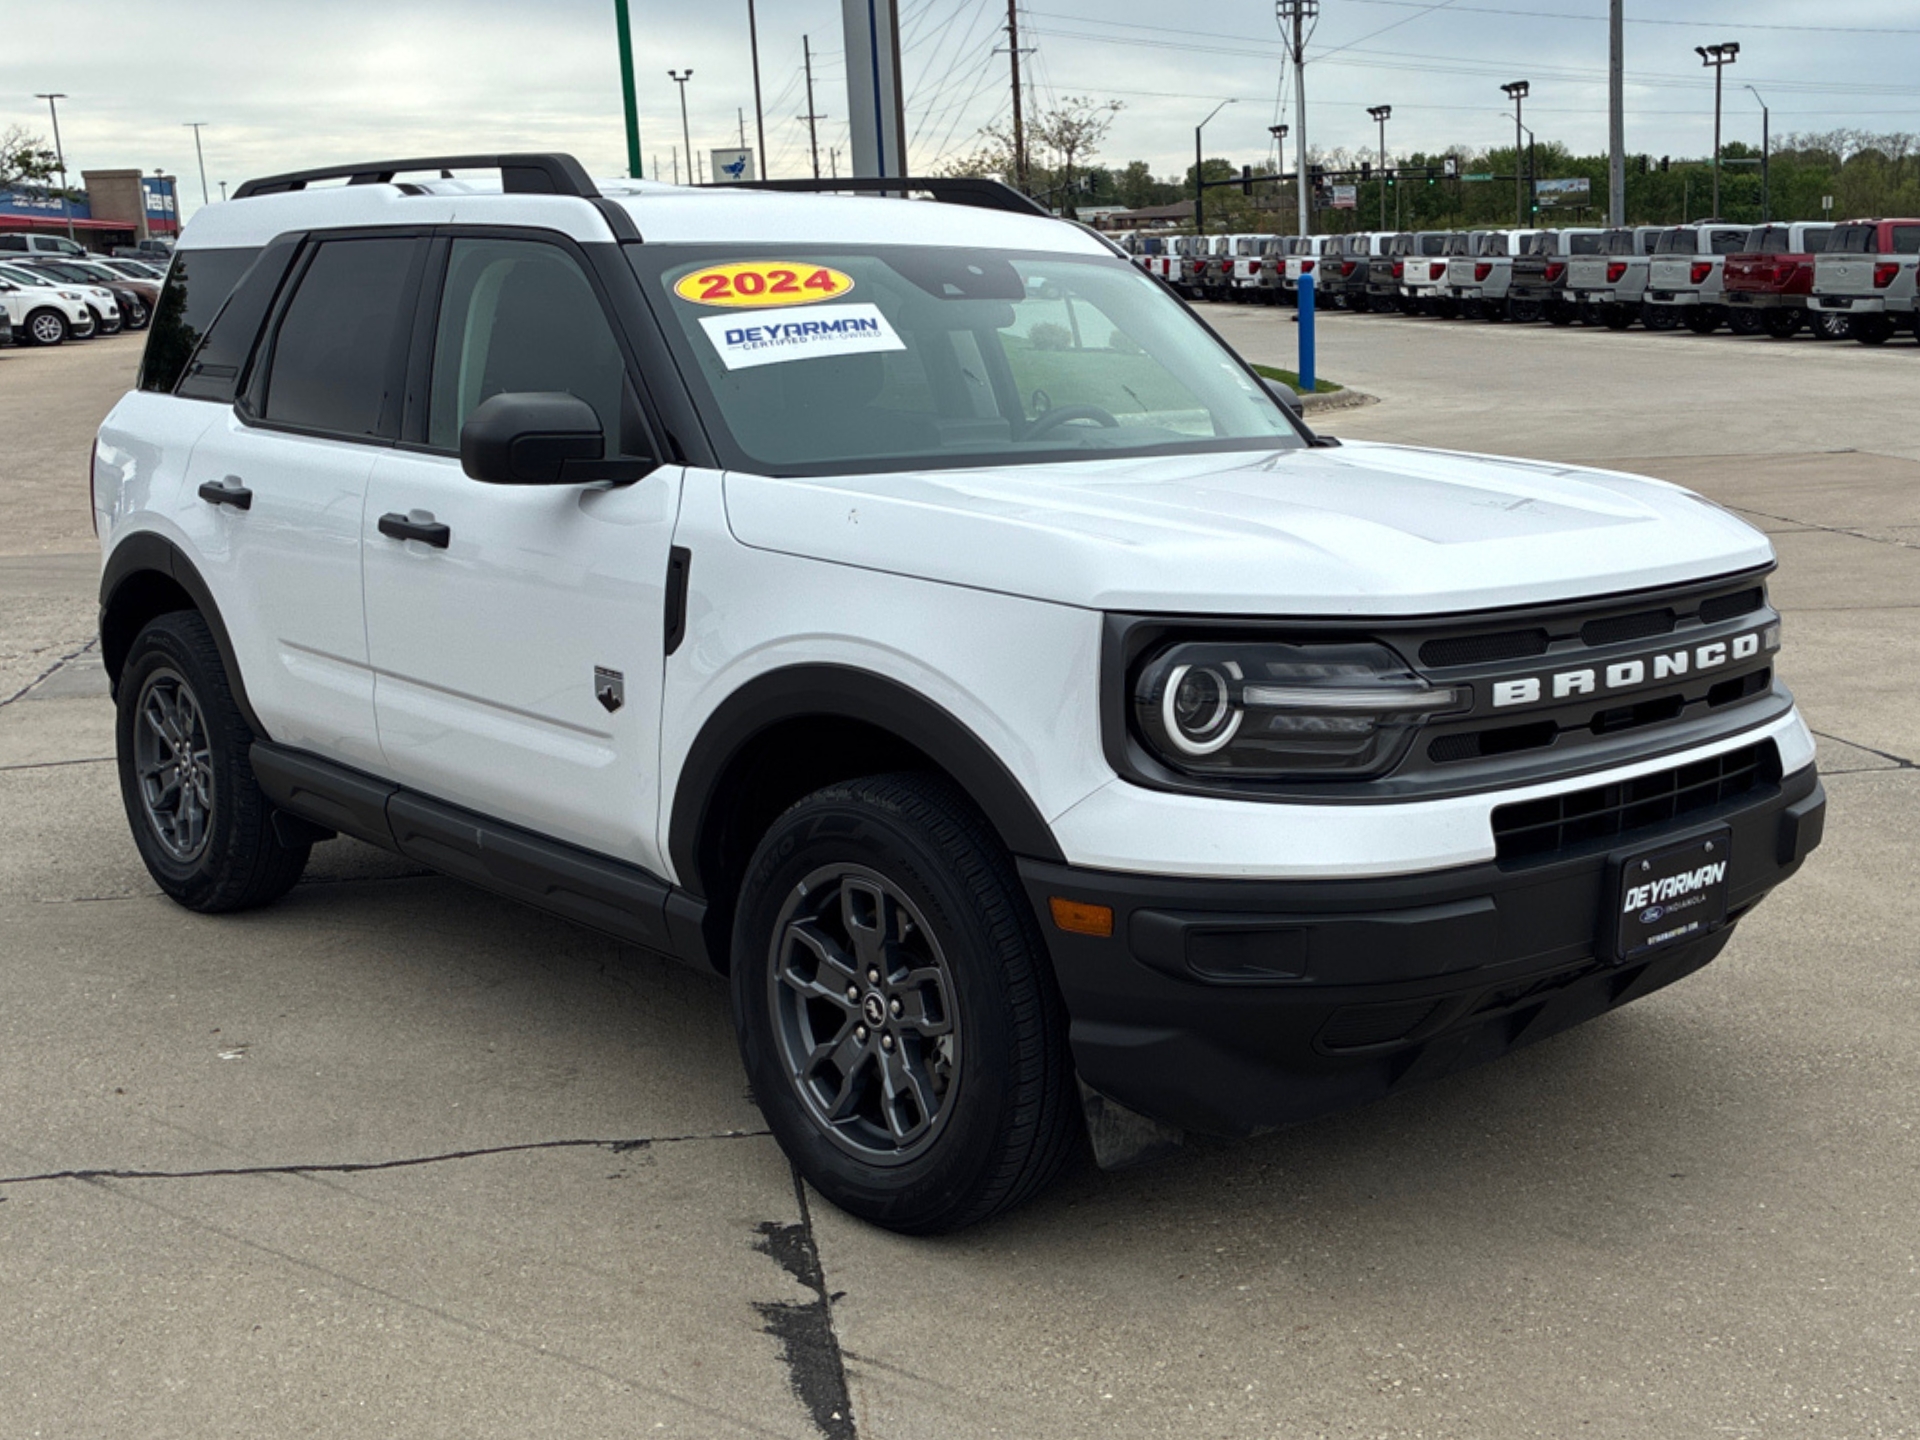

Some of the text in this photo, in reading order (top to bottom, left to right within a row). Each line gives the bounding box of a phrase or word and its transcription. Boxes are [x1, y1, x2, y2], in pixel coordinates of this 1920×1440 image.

[698, 269, 837, 300] 2024
[725, 317, 878, 346] DEYARMAN
[743, 329, 883, 351] CERTIFIED PRE-OWNED
[1492, 632, 1759, 708] BRONCO
[1623, 860, 1728, 913] DEYARMAN
